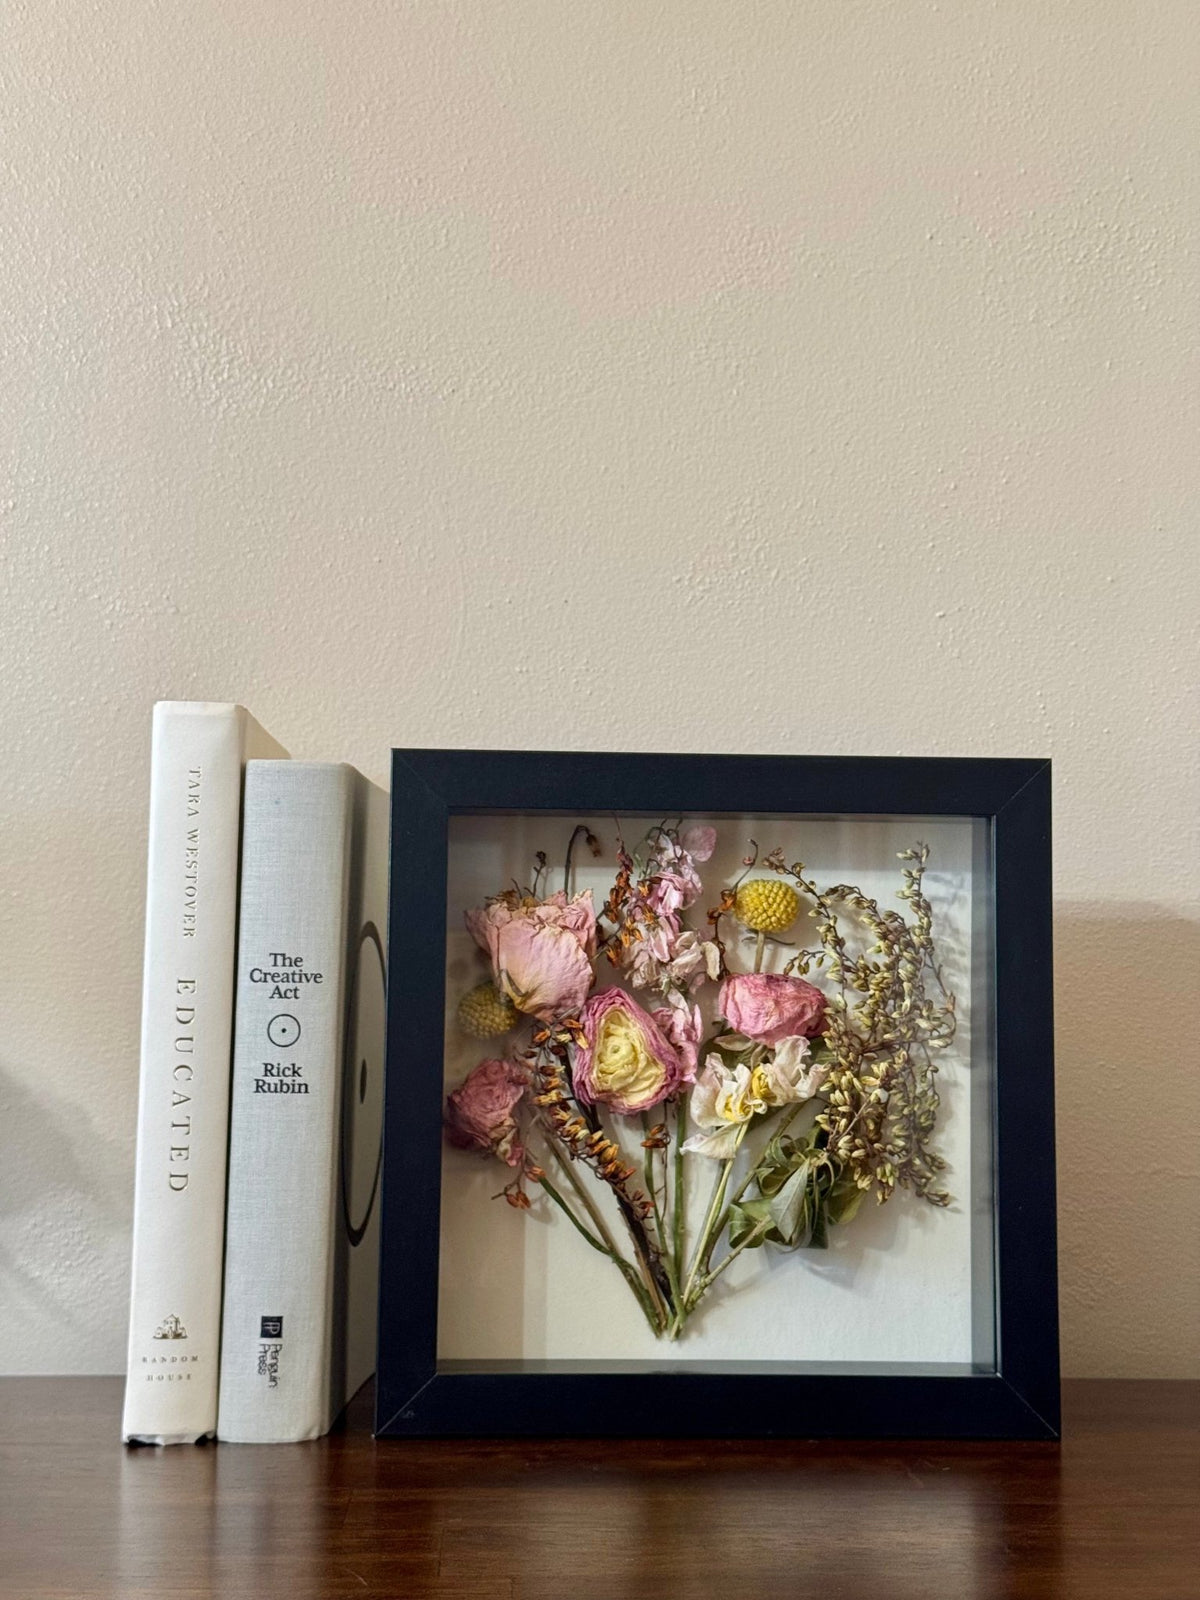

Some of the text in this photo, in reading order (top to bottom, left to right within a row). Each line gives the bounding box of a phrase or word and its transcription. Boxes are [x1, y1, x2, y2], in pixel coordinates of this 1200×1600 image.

[183, 766, 201, 938] TARA WESTOVER
[269, 952, 303, 968] The
[249, 968, 323, 984] Creative
[269, 985, 300, 999] Act
[262, 1062, 303, 1077] Rick
[169, 979, 196, 1192] EDUCATED
[253, 1078, 310, 1094] Rubin
[142, 1355, 199, 1363] RANDOM
[257, 1343, 271, 1375] Press
[267, 1343, 283, 1388] Penguin
